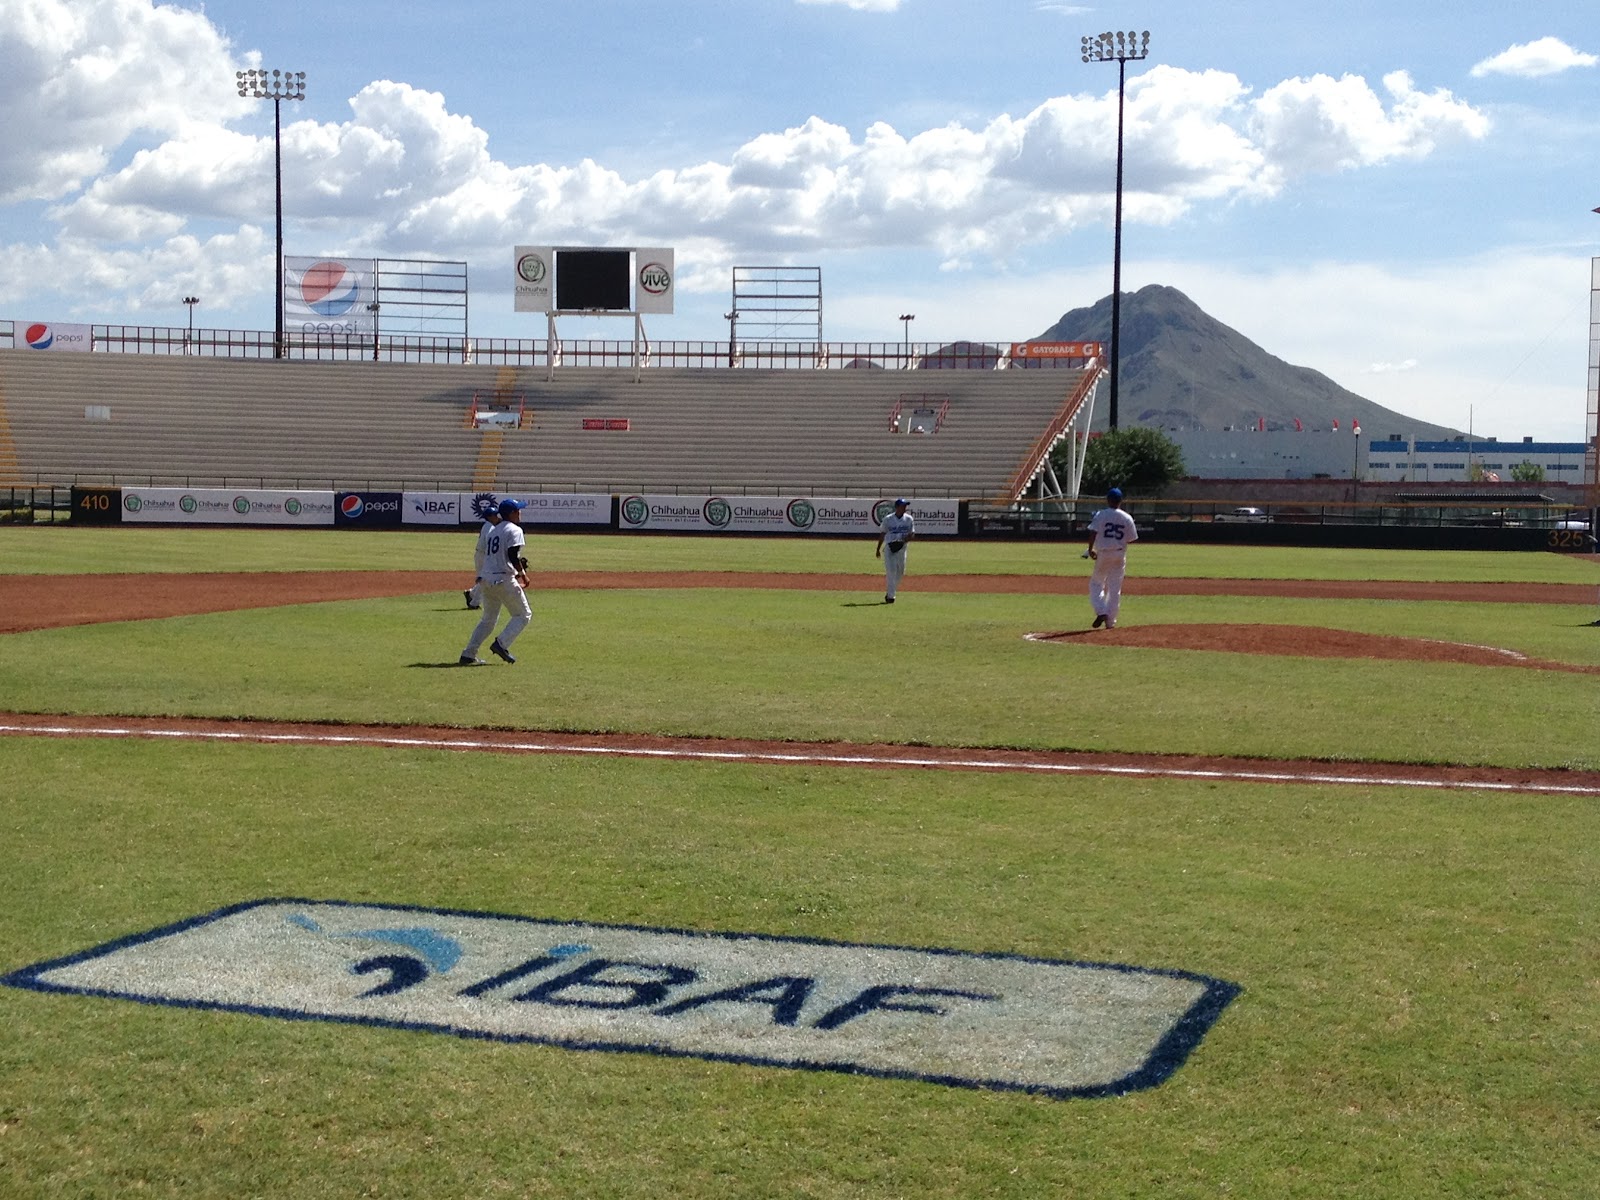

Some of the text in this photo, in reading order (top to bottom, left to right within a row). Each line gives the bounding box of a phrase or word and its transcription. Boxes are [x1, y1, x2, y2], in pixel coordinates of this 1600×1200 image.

[55, 333, 83, 343] pepsi
[1016, 343, 1093, 356] G GATORADE G
[80, 494, 110, 510] 410
[365, 500, 399, 512] pepsi
[424, 501, 456, 512] IBAF
[552, 499, 595, 507] BAFAR
[651, 505, 700, 515] Chihuahua
[733, 506, 784, 516] Chihuahua
[817, 507, 868, 518] Chihuahua
[1103, 522, 1125, 540] 25
[1548, 530, 1584, 547] 325
[487, 535, 500, 556] 18
[456, 954, 1004, 1031] IBAF
